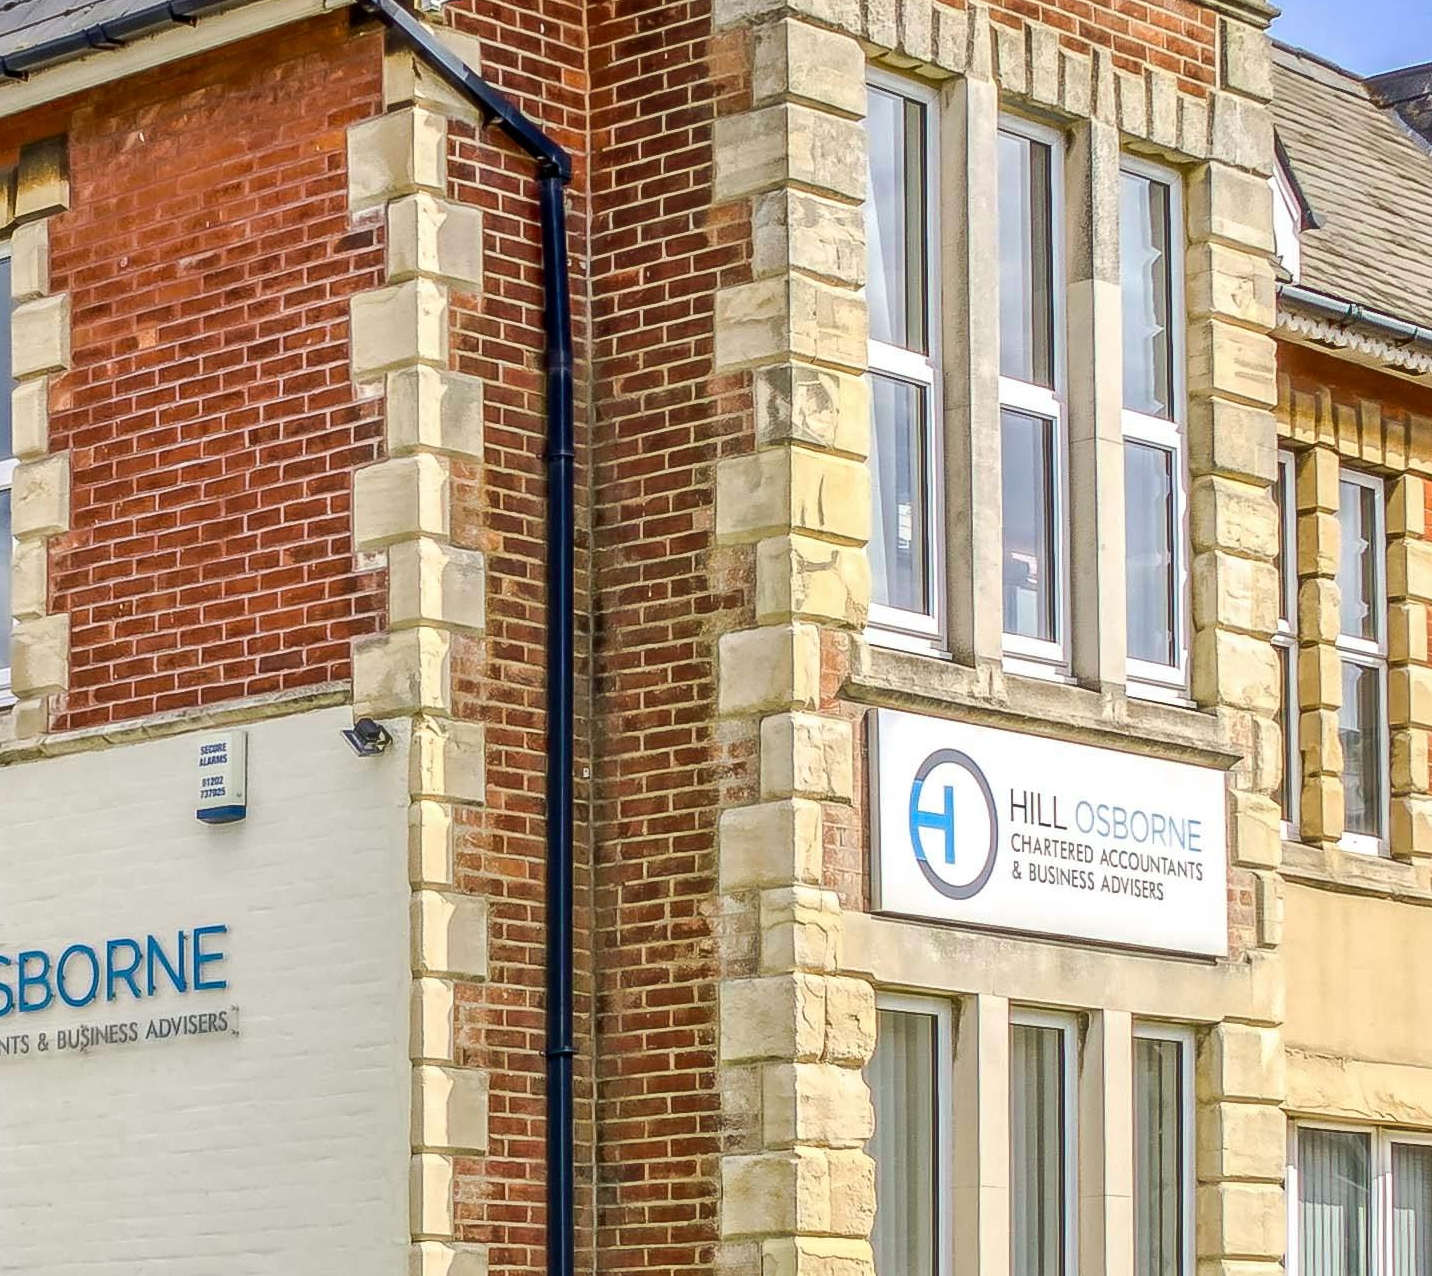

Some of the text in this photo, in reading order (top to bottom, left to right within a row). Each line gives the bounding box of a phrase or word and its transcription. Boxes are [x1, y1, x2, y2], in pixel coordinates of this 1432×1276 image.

[199, 754, 227, 767] ALARMS
[200, 742, 227, 755] SECURE
[202, 776, 223, 788] 01202
[1009, 788, 1202, 853] HILL OSBORNE
[1011, 833, 1203, 881] CHARTERED ACCOUNTANTS
[1012, 861, 1164, 901] & BUSINESS ADVISERS
[38, 1032, 49, 1051] &
[57, 1022, 138, 1050] BUSINESS
[145, 1011, 228, 1039] ADVISERS
